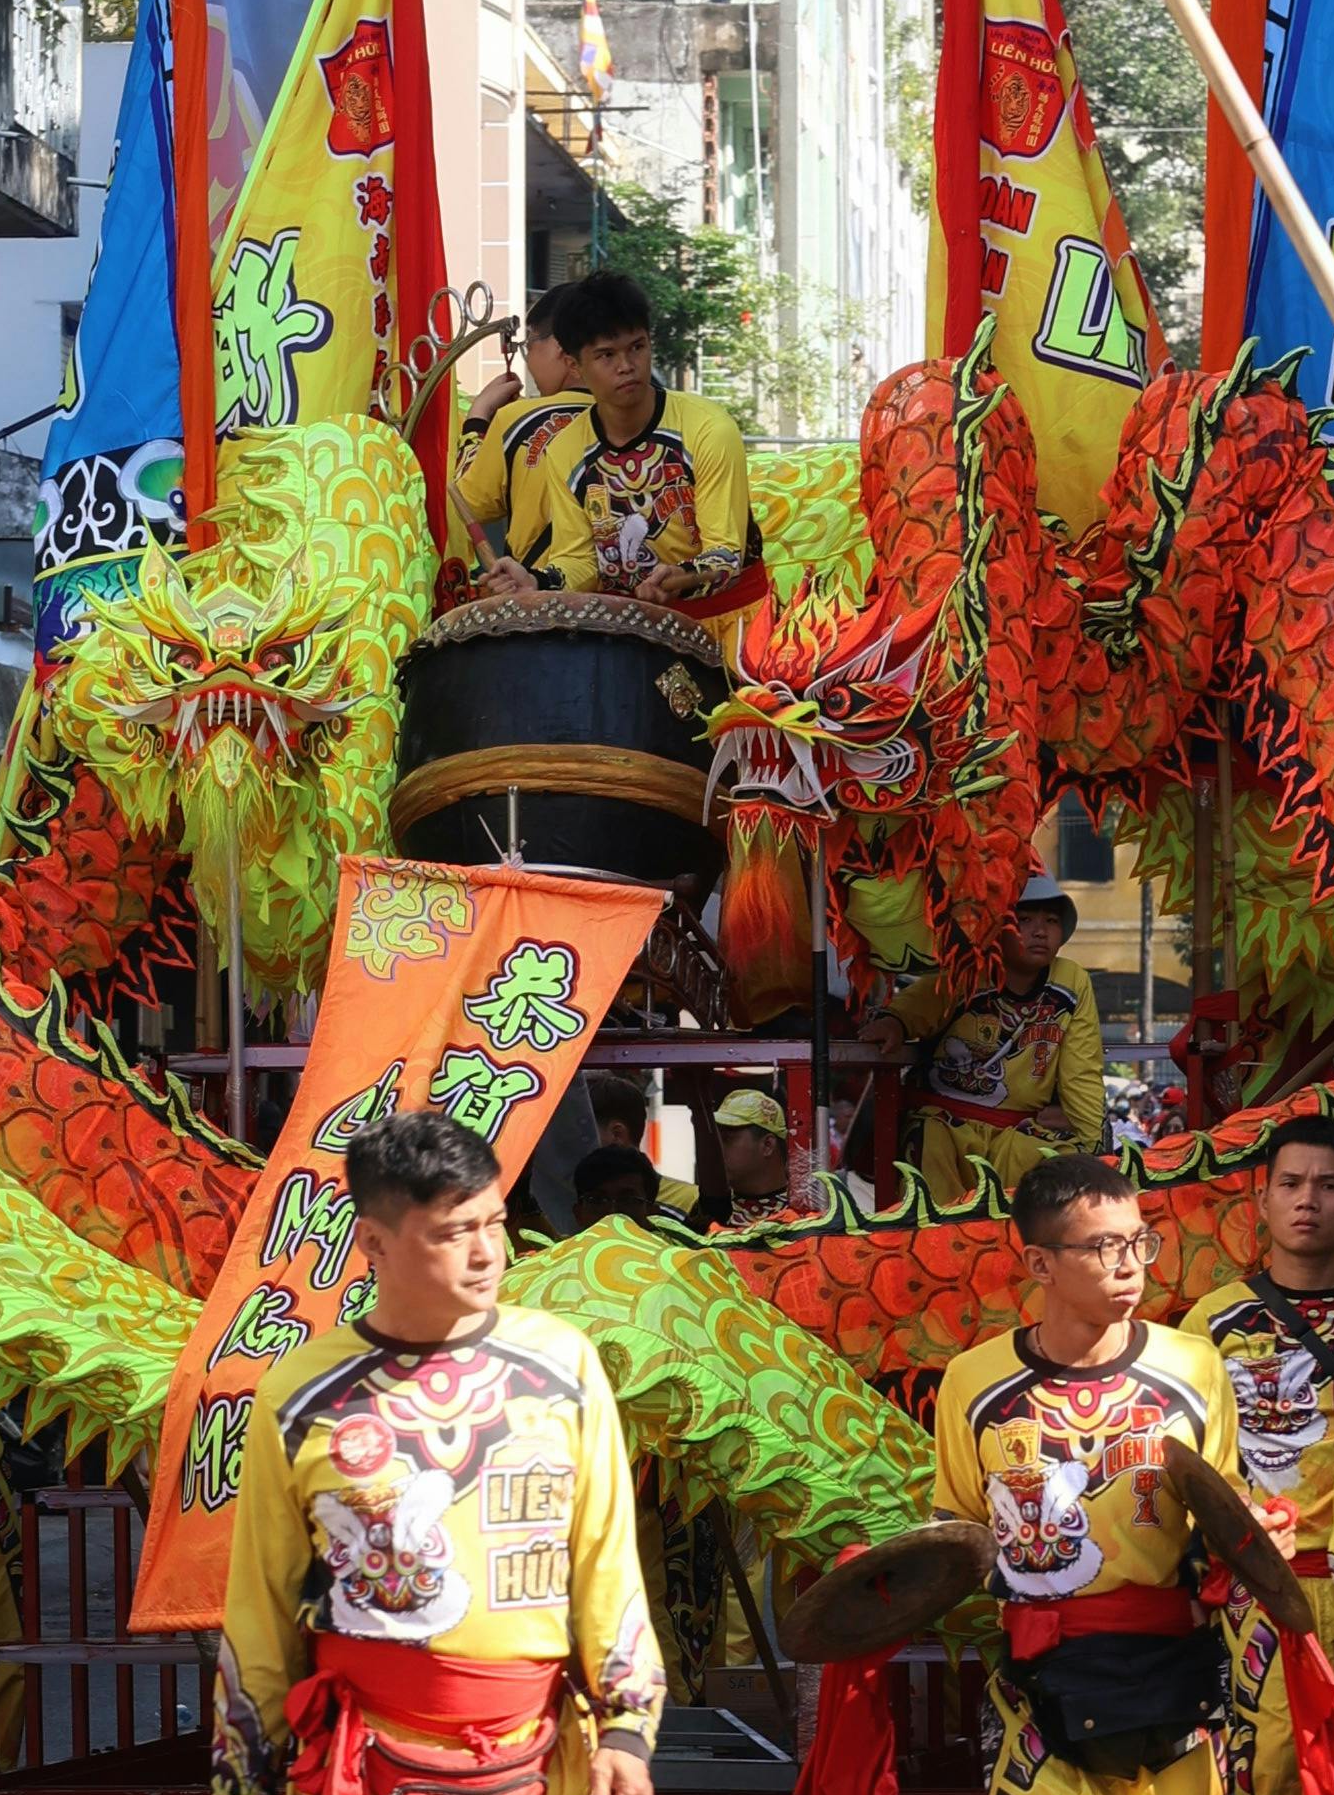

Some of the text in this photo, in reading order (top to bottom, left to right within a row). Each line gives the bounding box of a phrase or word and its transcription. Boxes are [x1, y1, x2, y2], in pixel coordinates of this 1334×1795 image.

[990, 41, 1027, 63] LIÊN
[979, 175, 1037, 235] OÀN
[186, 1403, 251, 1501] Mớ
[487, 1461, 574, 1524] LIÊN
